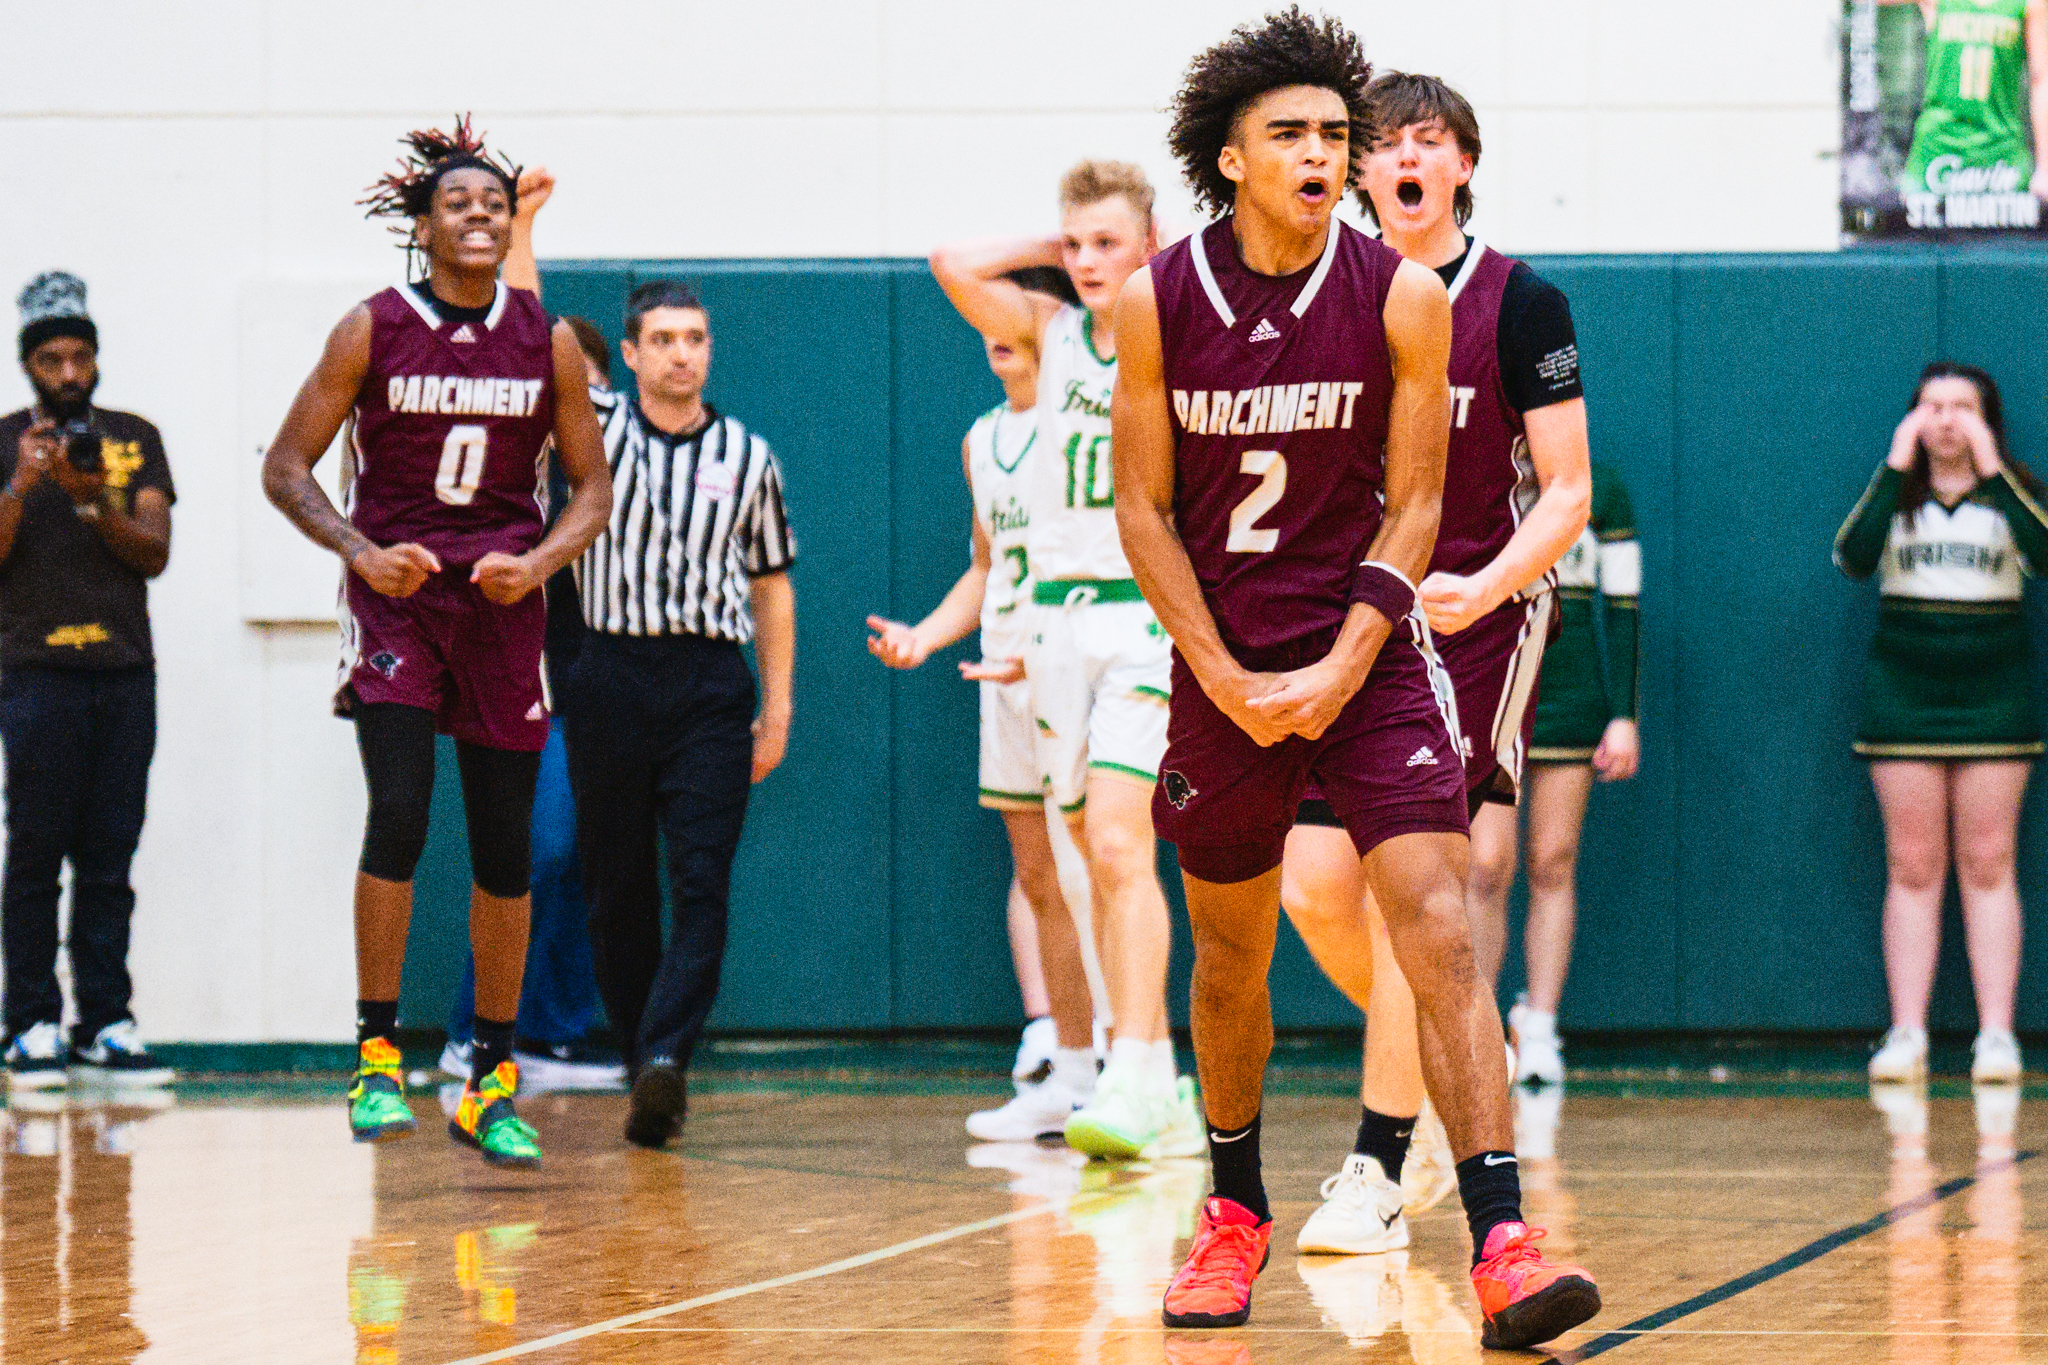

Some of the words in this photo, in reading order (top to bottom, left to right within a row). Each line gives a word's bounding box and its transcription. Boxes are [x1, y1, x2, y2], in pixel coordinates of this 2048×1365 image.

[1945, 192, 2040, 229] MARTIN
[1249, 330, 1281, 343] adidas
[387, 375, 543, 417] PARCHMENT
[1172, 381, 1364, 436] PARCHMENT
[434, 424, 488, 506] 0
[1064, 432, 1115, 509] 10
[1225, 450, 1287, 553] 2
